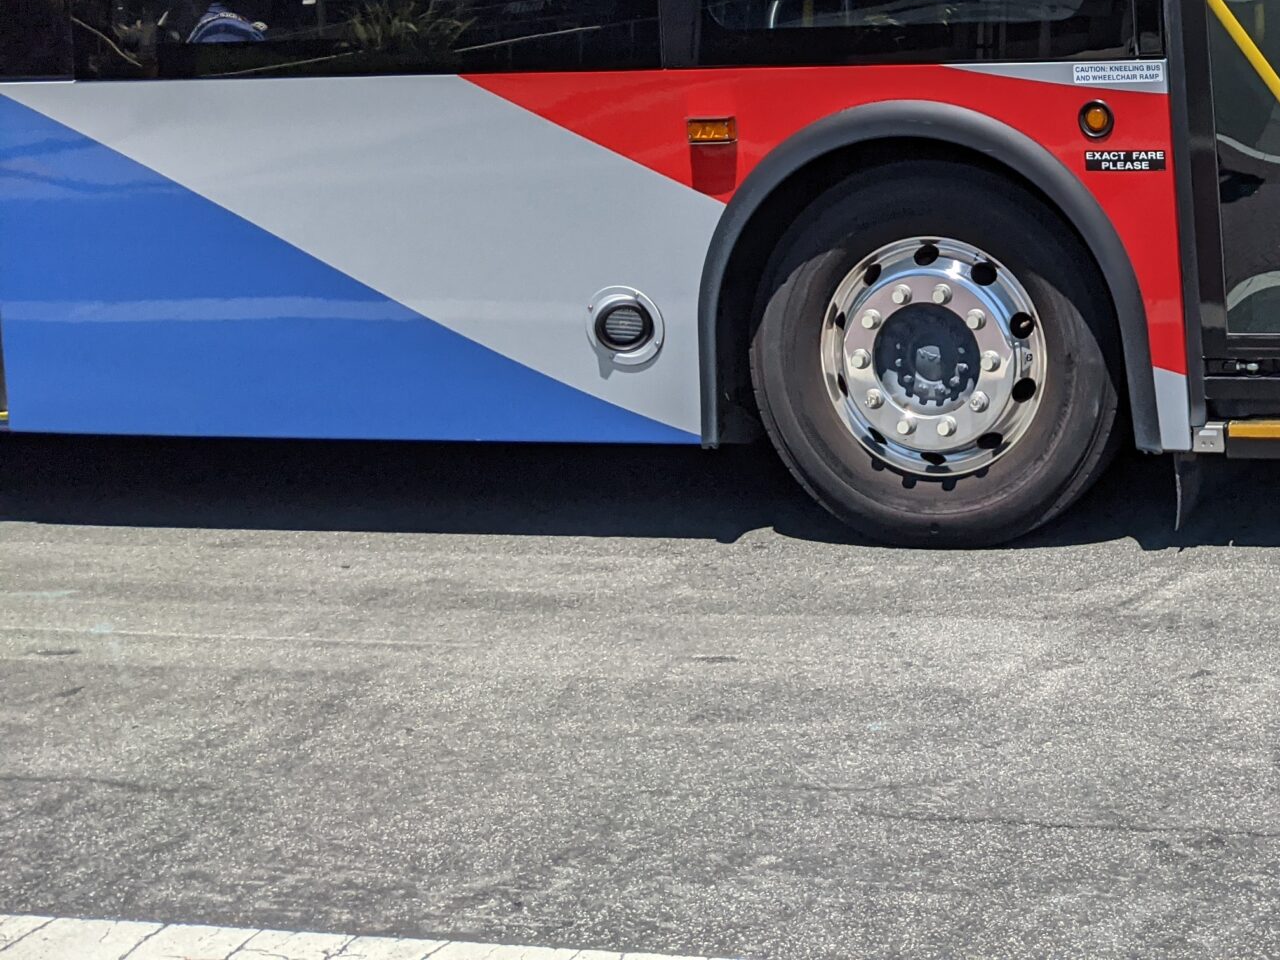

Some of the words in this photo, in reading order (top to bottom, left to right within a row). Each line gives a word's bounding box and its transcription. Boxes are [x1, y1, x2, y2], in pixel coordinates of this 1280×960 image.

[1075, 65, 1108, 73] CAUTION:
[1109, 64, 1144, 72] KNEELING
[1092, 73, 1137, 81] WHEELCHAIR
[1085, 151, 1126, 160] EXACT
[1132, 151, 1164, 159] FARE
[1101, 161, 1150, 170] PLEASE
